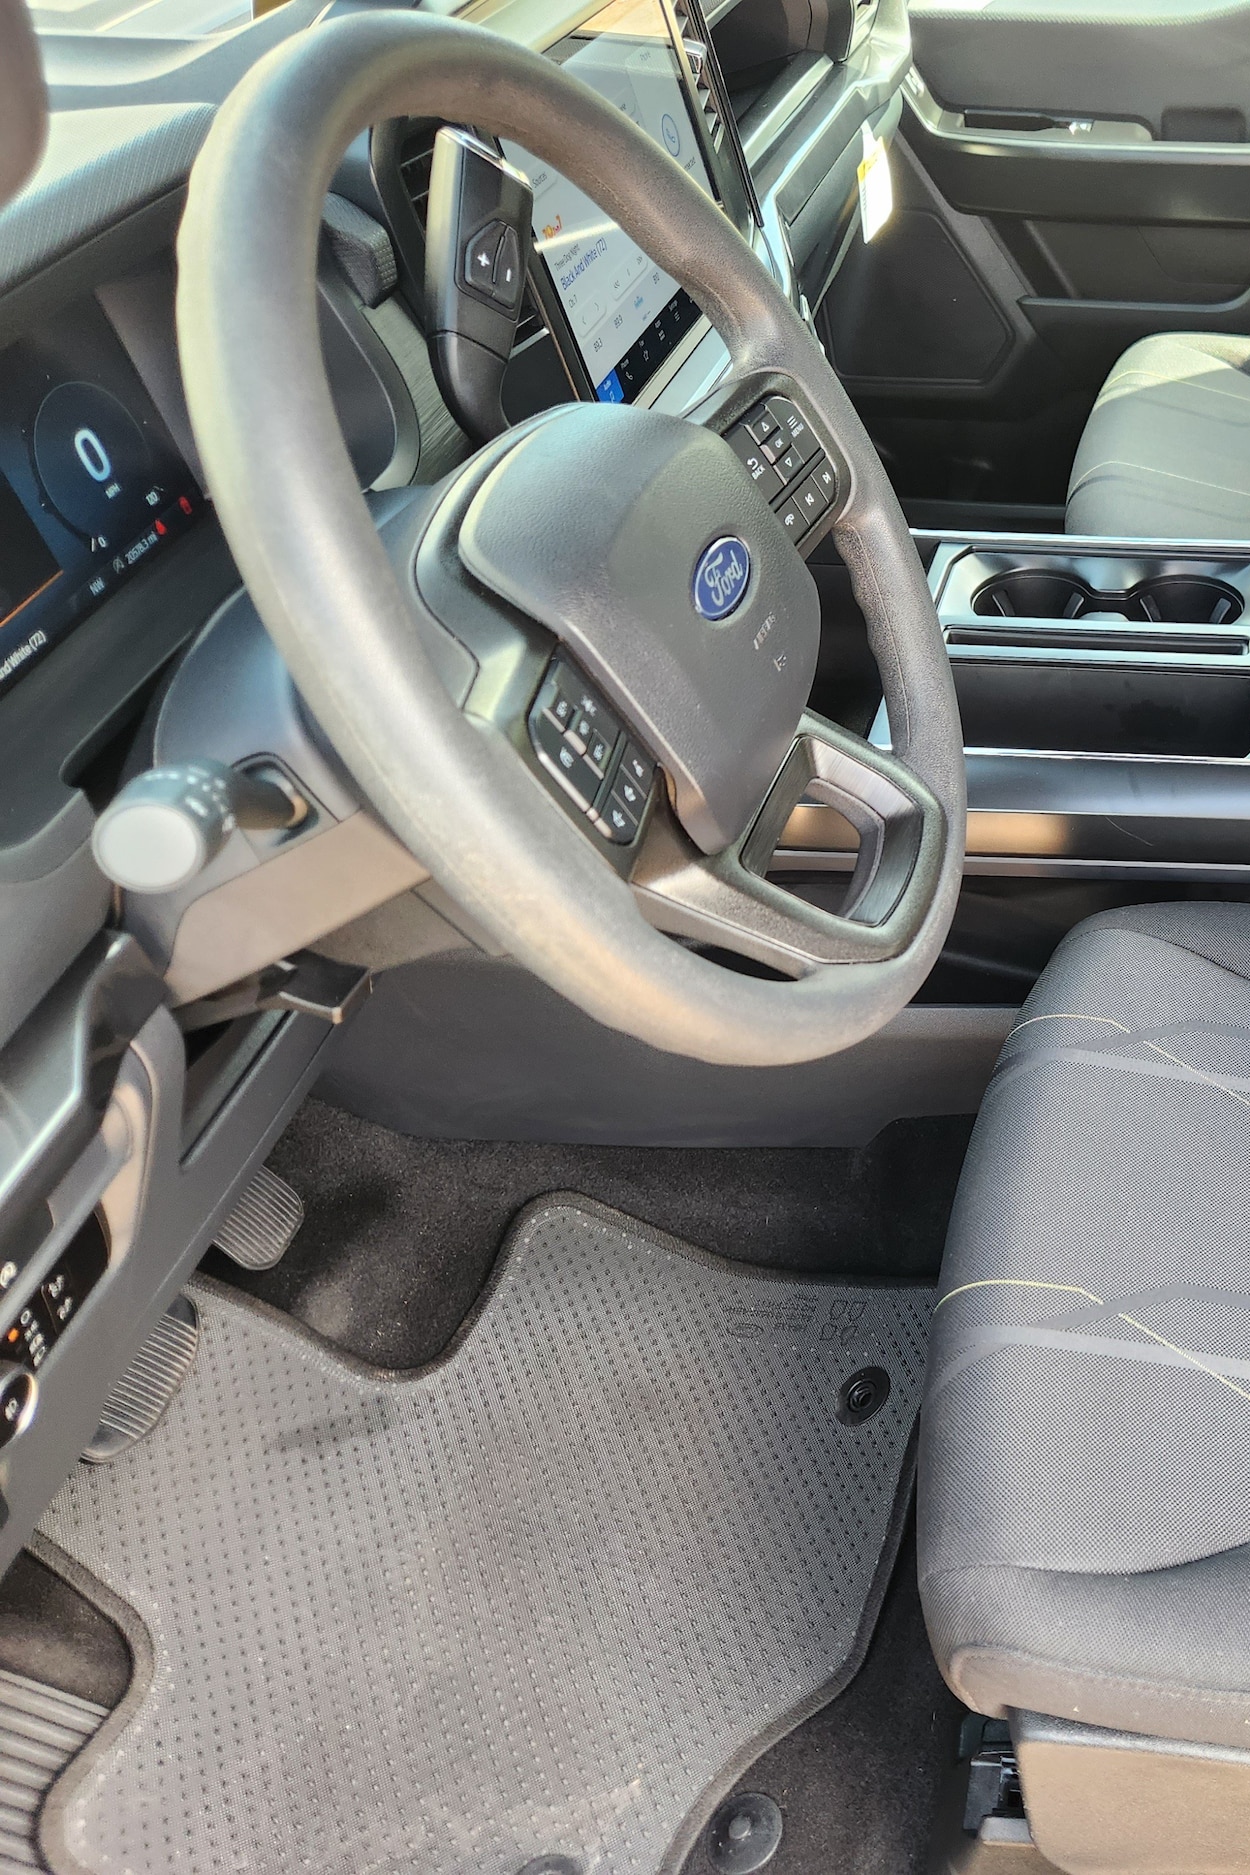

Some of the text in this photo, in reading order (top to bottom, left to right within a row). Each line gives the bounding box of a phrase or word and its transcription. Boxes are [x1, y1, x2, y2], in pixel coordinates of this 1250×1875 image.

[560, 237, 608, 290] Black And White (72)
[74, 427, 112, 482] 0
[105, 482, 121, 499] MPH
[97, 536, 107, 548] 0
[147, 530, 159, 544] mi
[89, 577, 105, 596] NW
[704, 549, 744, 607] Ford
[7, 644, 33, 668] White
[28, 630, 47, 651] (72)
